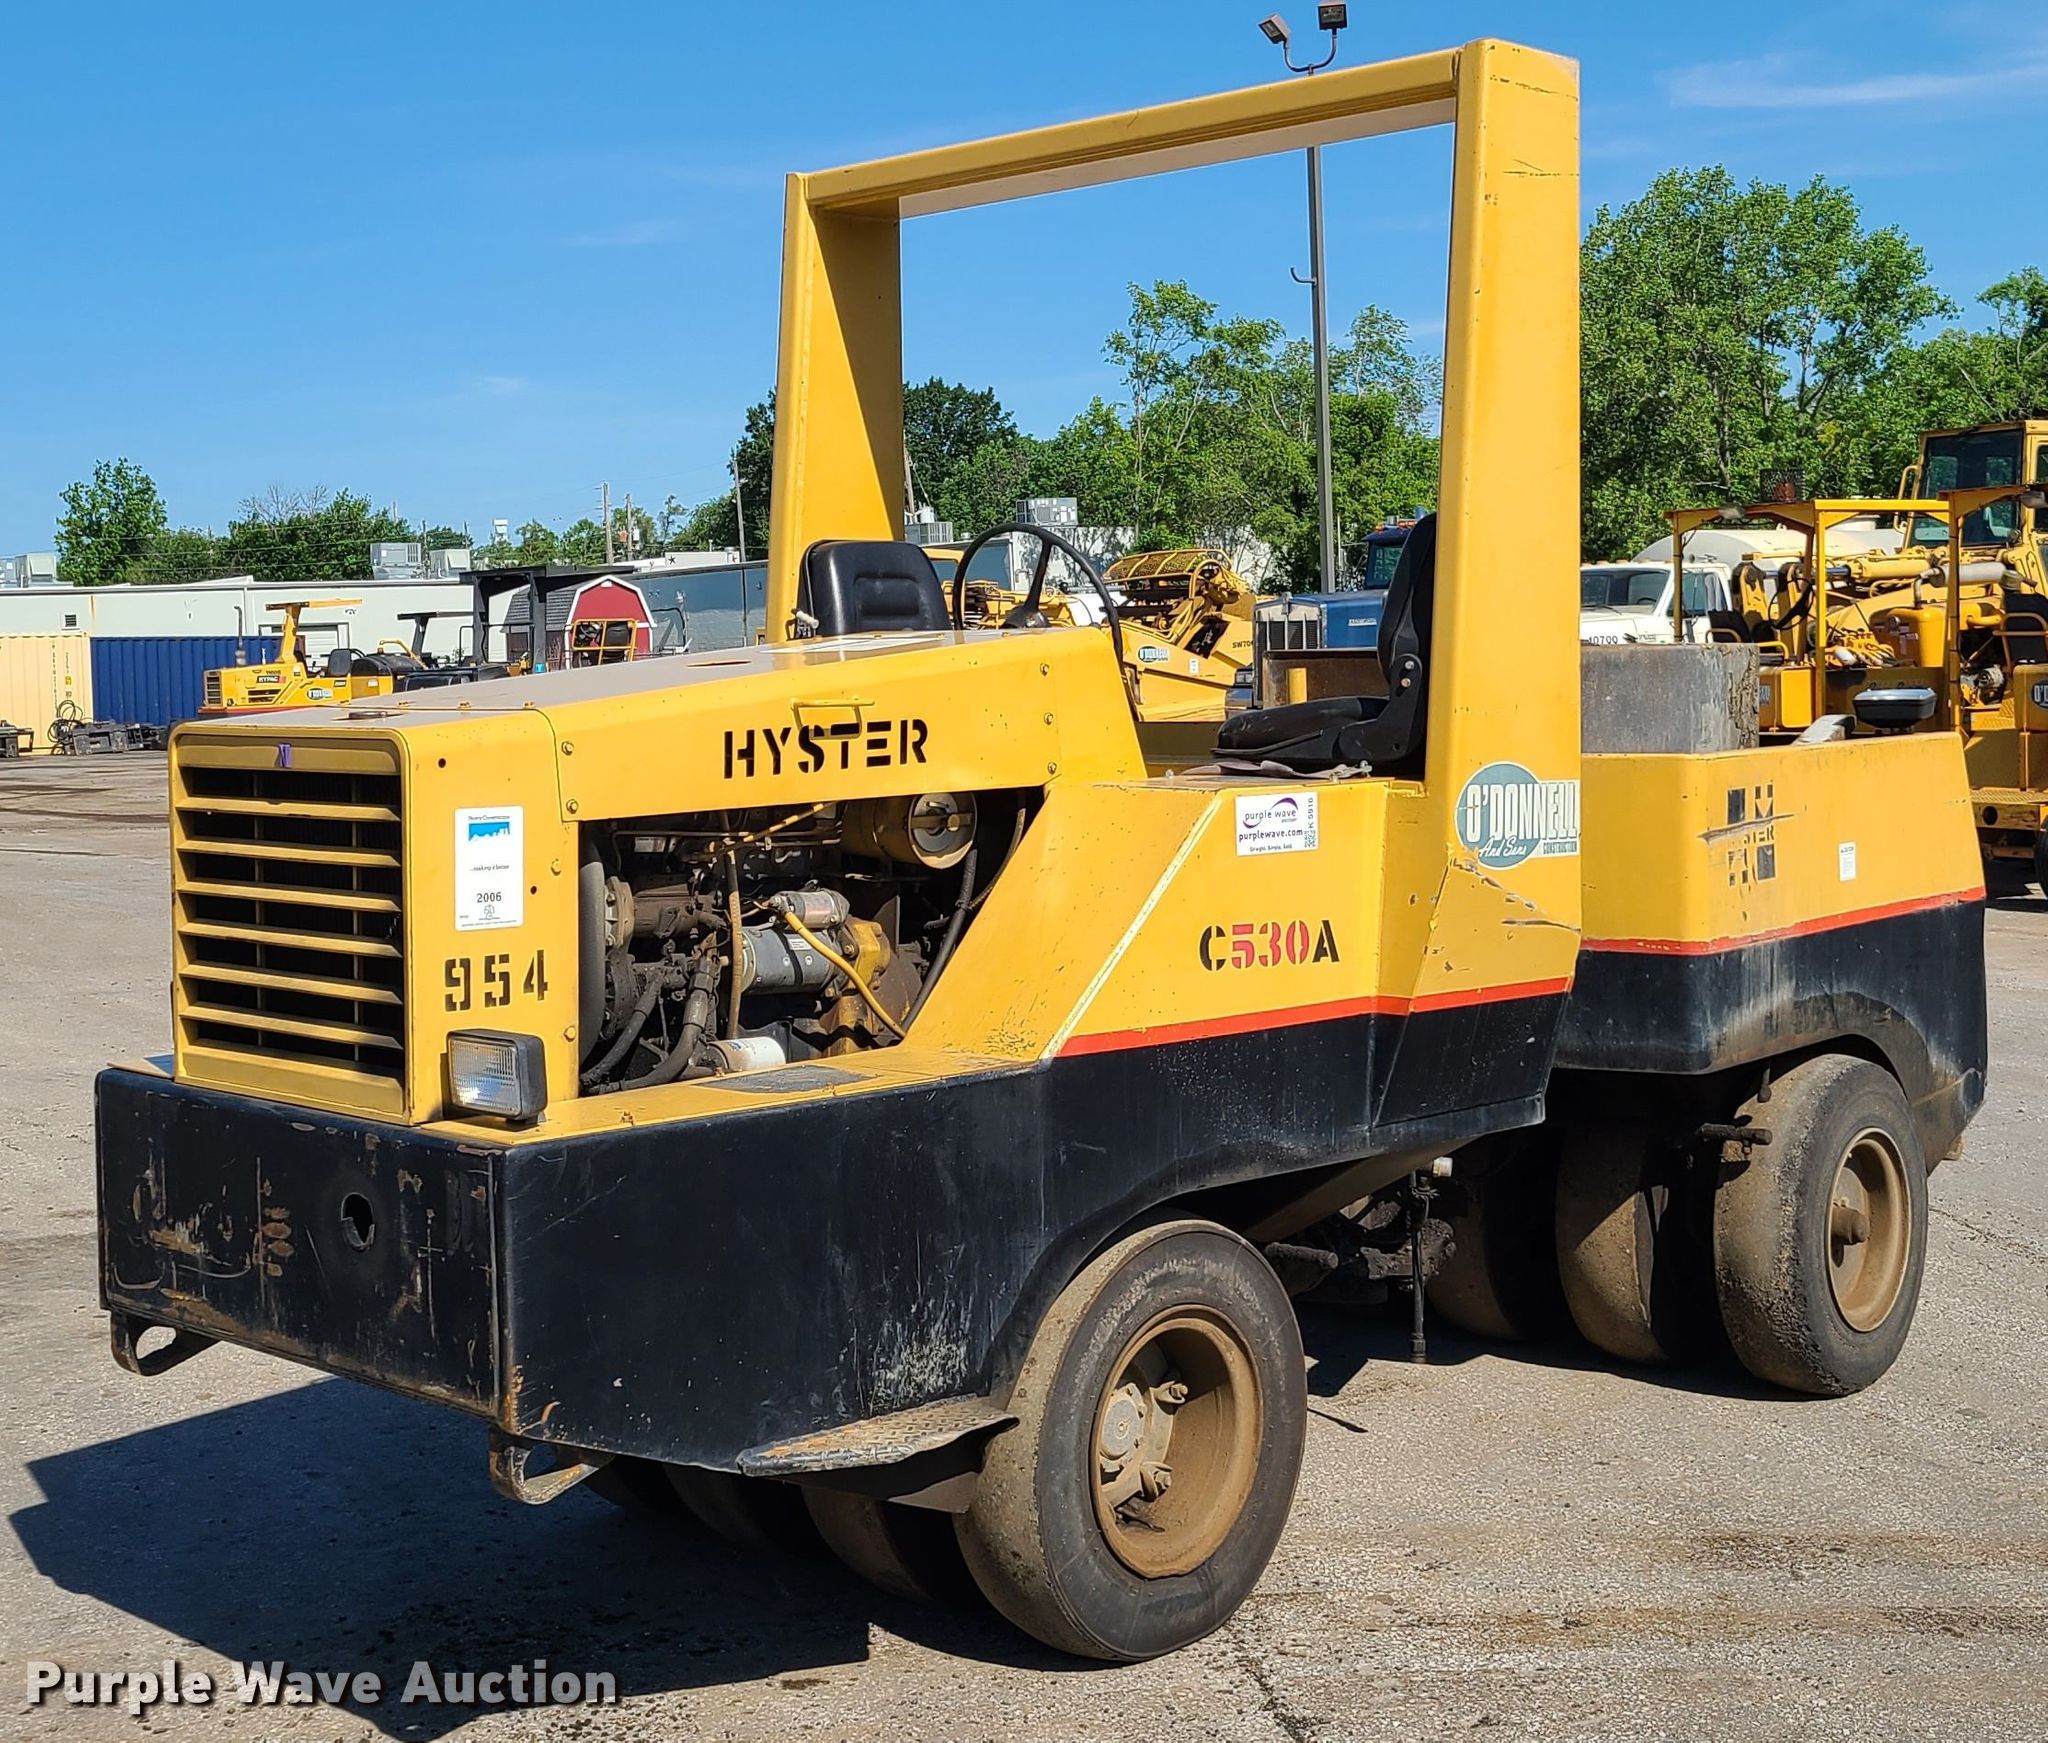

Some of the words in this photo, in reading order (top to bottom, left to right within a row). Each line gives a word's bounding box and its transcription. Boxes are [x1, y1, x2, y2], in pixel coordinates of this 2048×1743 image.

[723, 718, 929, 780] HYSTER
[1244, 810, 1272, 822] purple
[1274, 809, 1297, 818] wave
[1465, 782, 1578, 843] O'DONNELL
[1238, 829, 1304, 843] purplewave.com
[1478, 835, 1504, 857] And
[476, 892, 502, 903] 2006
[1199, 919, 1341, 972] C530A
[444, 949, 549, 1012] 954
